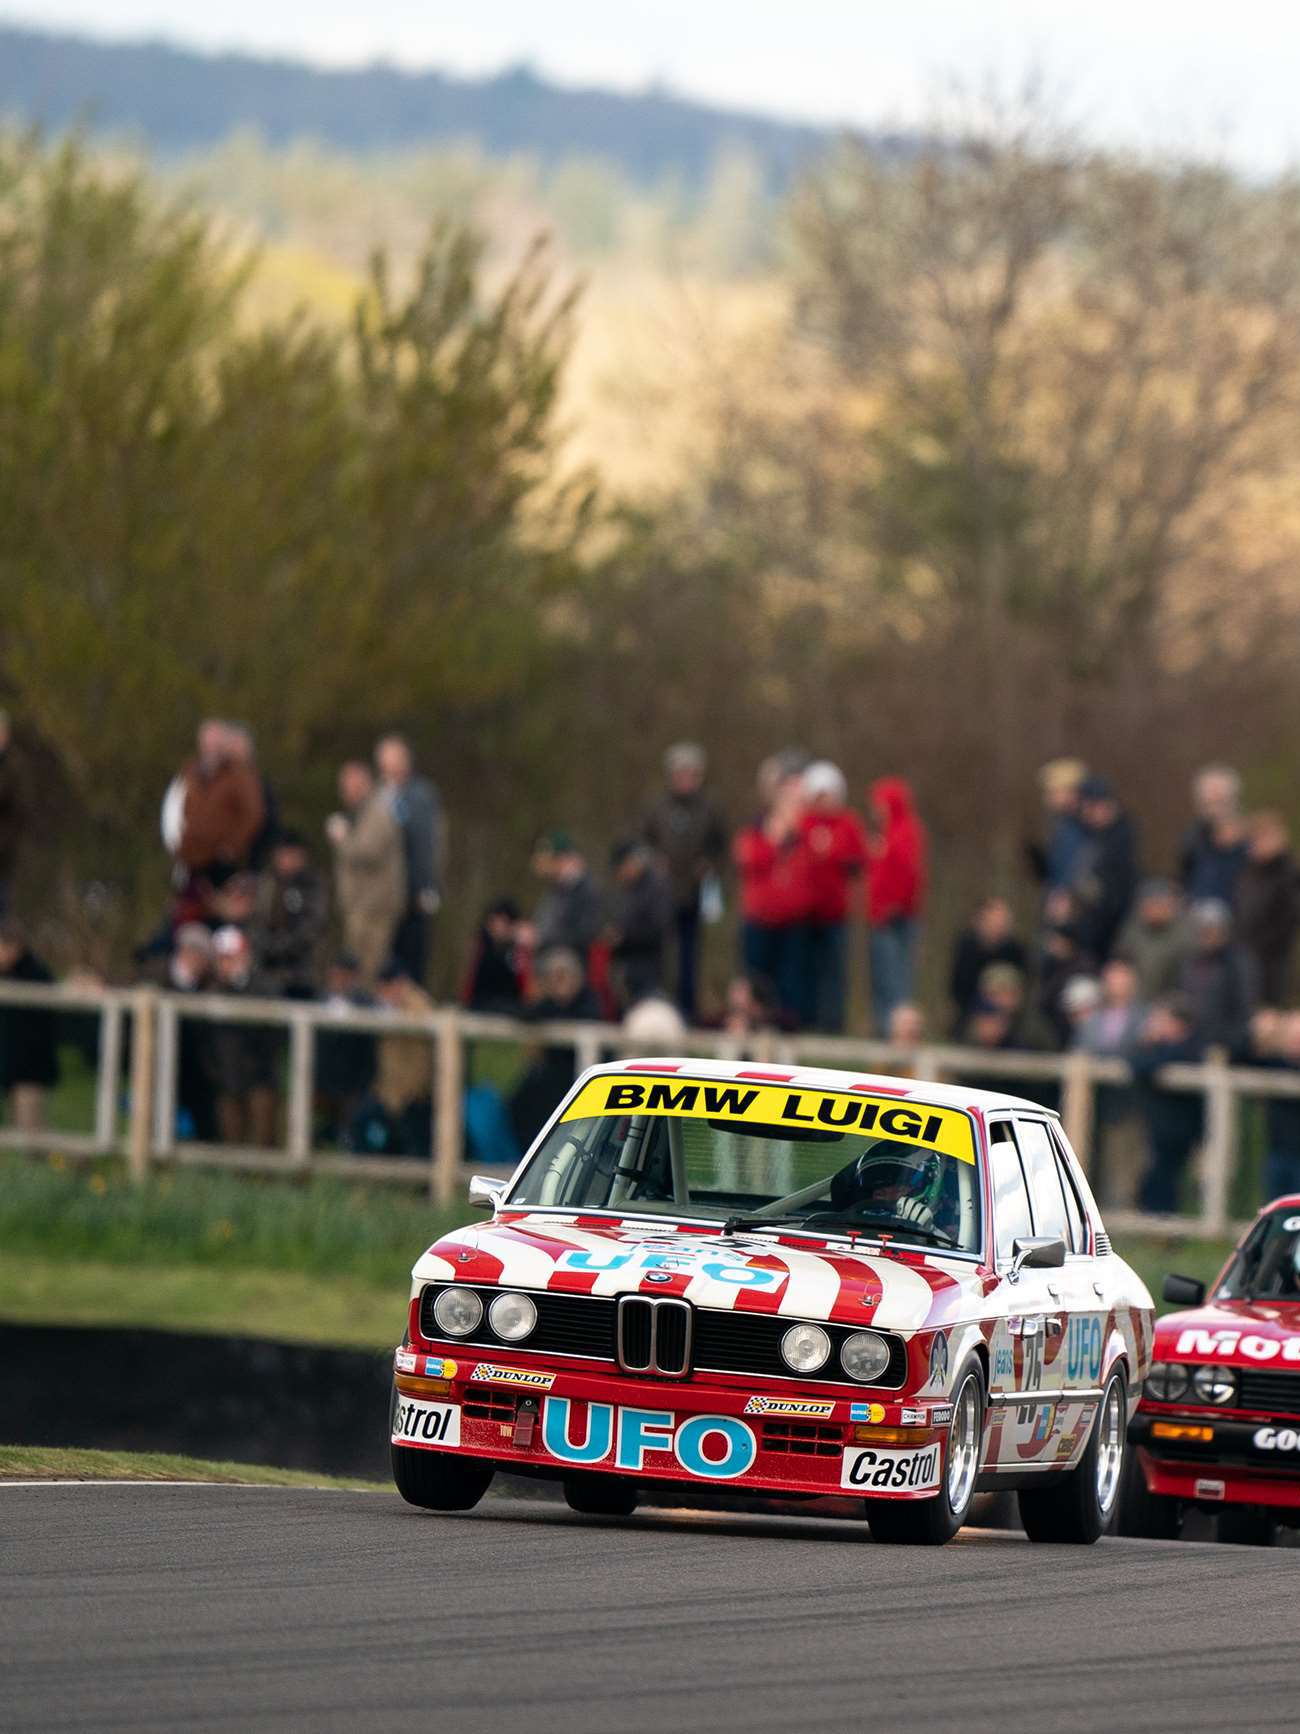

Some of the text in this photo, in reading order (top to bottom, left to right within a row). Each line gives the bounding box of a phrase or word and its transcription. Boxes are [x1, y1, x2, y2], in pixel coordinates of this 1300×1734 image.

[604, 1084, 943, 1143] BMW LUIGI
[566, 1250, 775, 1285] UFO
[1067, 1316, 1102, 1381] UFO
[492, 1370, 552, 1384] DUNLOP
[398, 1403, 453, 1441] strol
[767, 1402, 832, 1413] DUNLOP
[541, 1395, 758, 1479] UFO
[849, 1447, 937, 1487] Castrol
